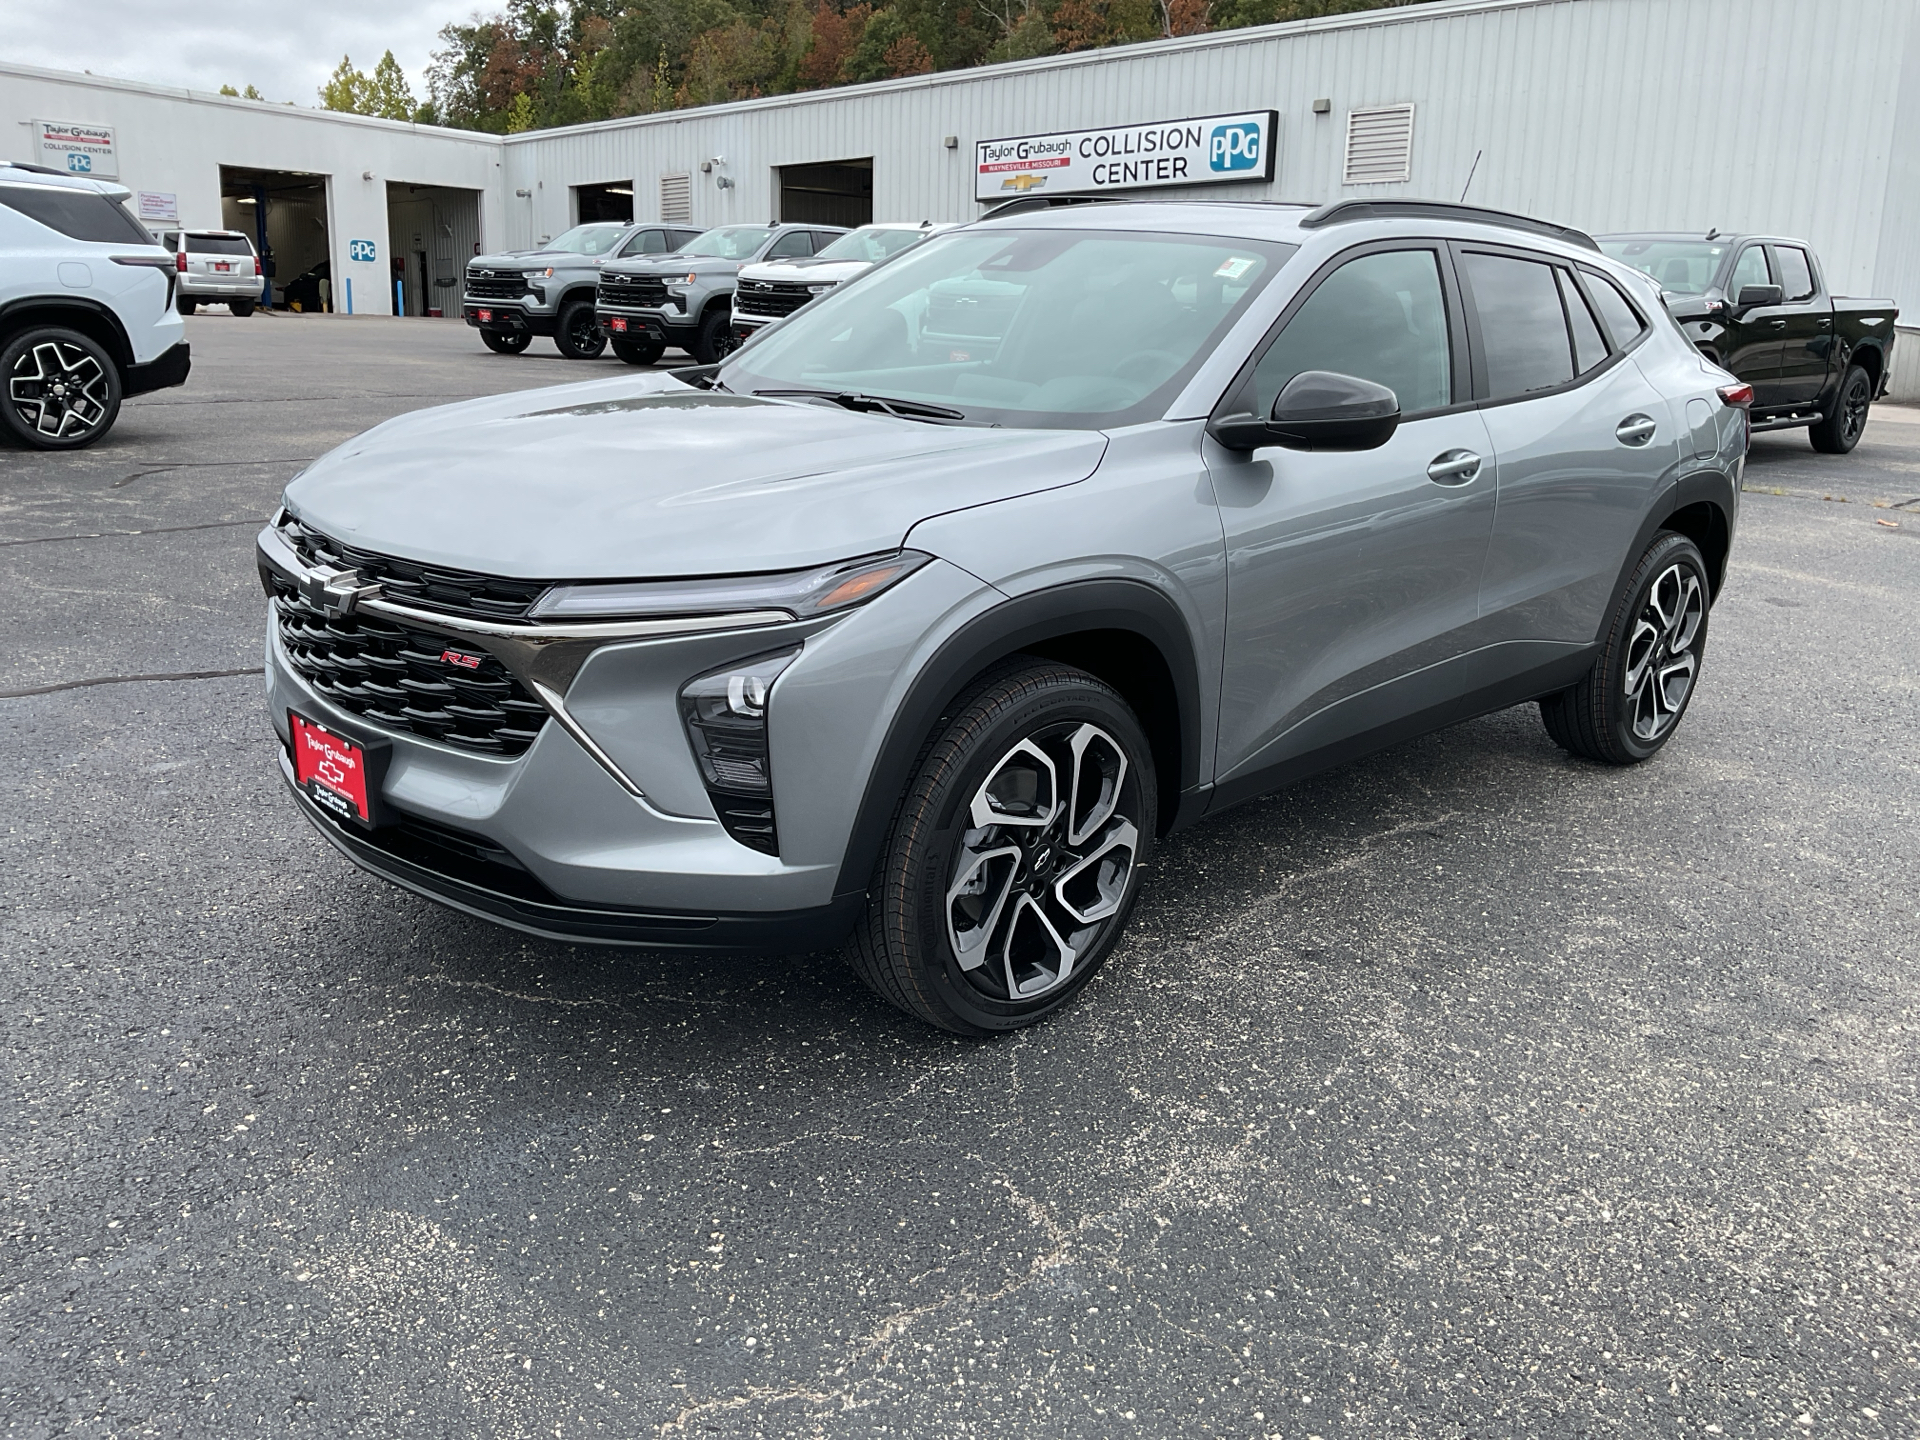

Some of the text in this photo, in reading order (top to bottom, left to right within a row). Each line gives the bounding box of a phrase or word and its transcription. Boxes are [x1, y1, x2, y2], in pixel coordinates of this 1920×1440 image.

[43, 124, 110, 138] Taylor Grubaugh
[43, 143, 82, 152] COLLISION
[980, 139, 1071, 163] Taylor Grubaugh
[1079, 126, 1258, 168] COLLISION PPG
[68, 155, 91, 171] PPG
[1031, 160, 1061, 169] MISSOURI
[1092, 156, 1188, 185] CENTER
[351, 241, 375, 260] PPG
[440, 650, 481, 669] RS
